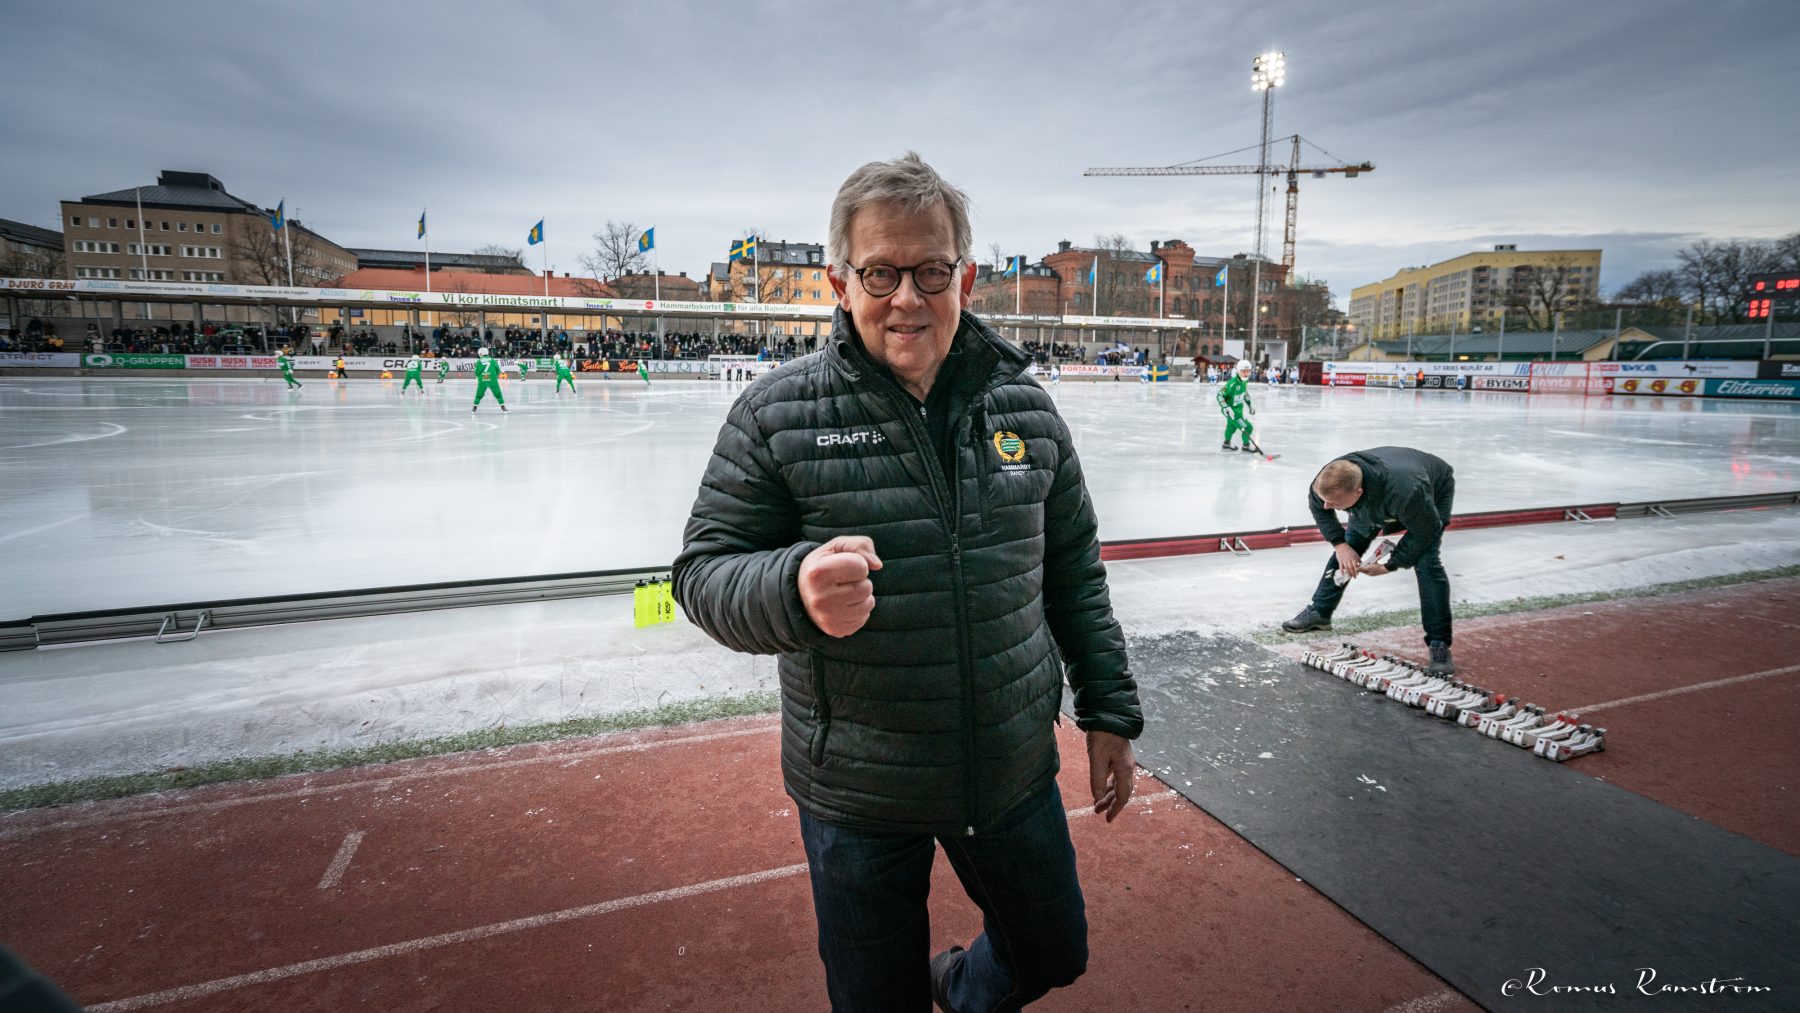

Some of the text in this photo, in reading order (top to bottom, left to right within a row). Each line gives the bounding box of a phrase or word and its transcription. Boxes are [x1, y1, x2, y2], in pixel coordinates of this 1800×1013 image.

[442, 293, 454, 303] Vi
[459, 293, 479, 304] kör
[482, 294, 559, 307] klimatsmart
[660, 302, 722, 311] Hammarbykortet
[749, 304, 763, 312] alla
[115, 357, 183, 366] Q-GRUPPEN
[383, 359, 431, 368] CRT
[481, 361, 490, 373] 7
[1486, 379, 1531, 388] BYGMA
[1717, 380, 1796, 396] Elitserien
[816, 431, 870, 447] CRAFT
